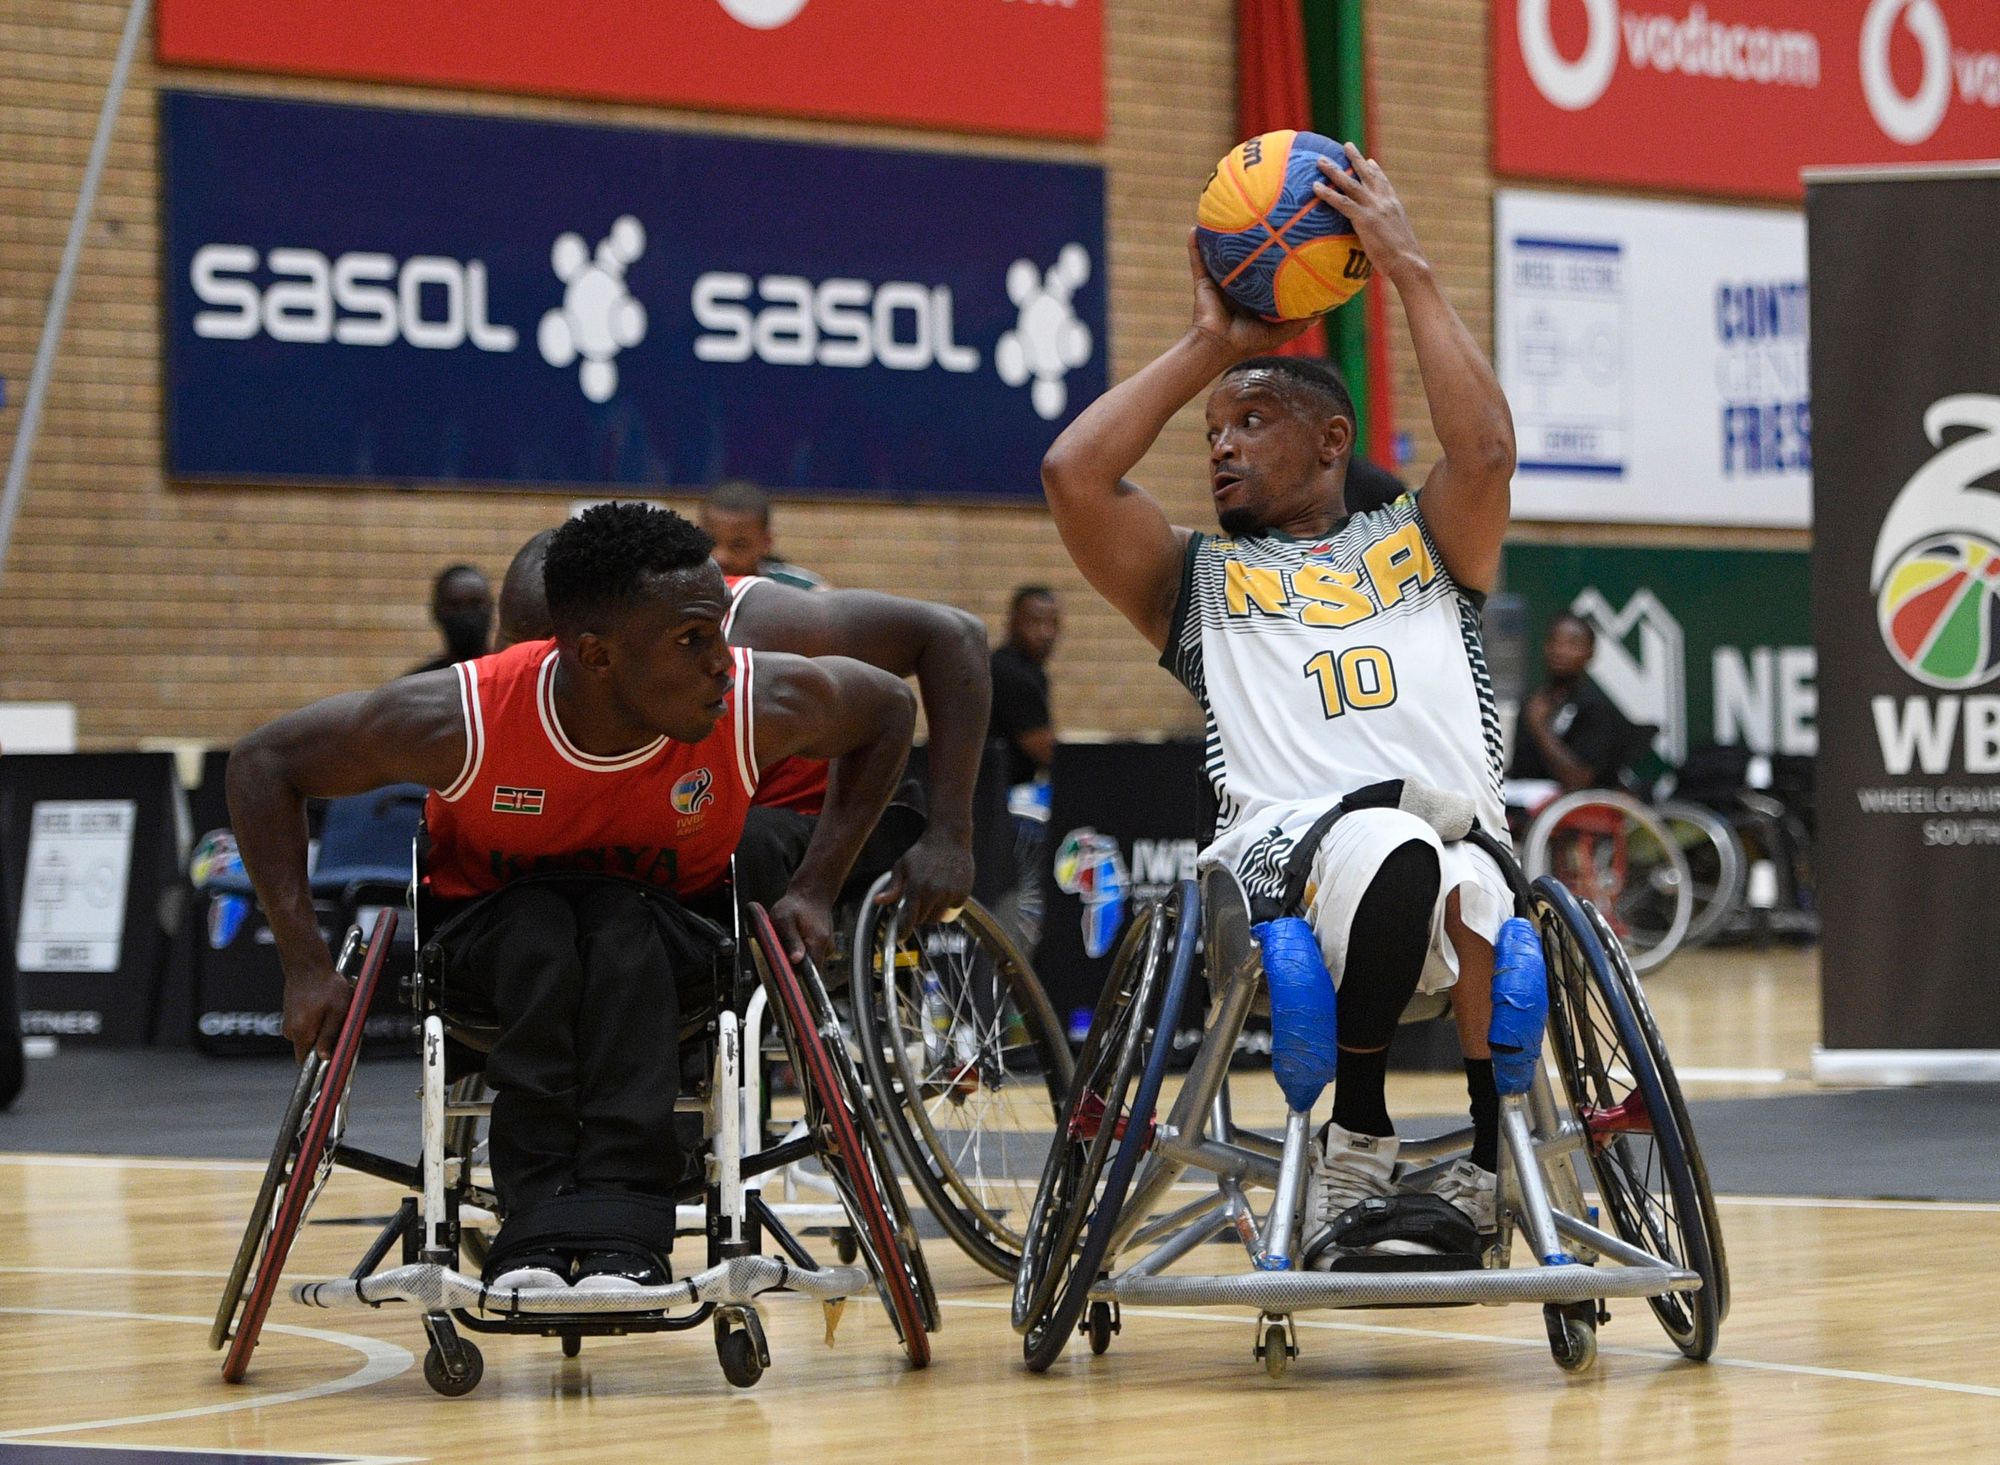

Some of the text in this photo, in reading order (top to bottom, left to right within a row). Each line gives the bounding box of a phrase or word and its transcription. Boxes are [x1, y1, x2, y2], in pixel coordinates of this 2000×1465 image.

[1621, 4, 1821, 89] vodacom
[1223, 522, 1437, 629] NSA
[1303, 645, 1398, 720] 10
[1712, 645, 1819, 759] NE
[1871, 693, 2000, 775] WB
